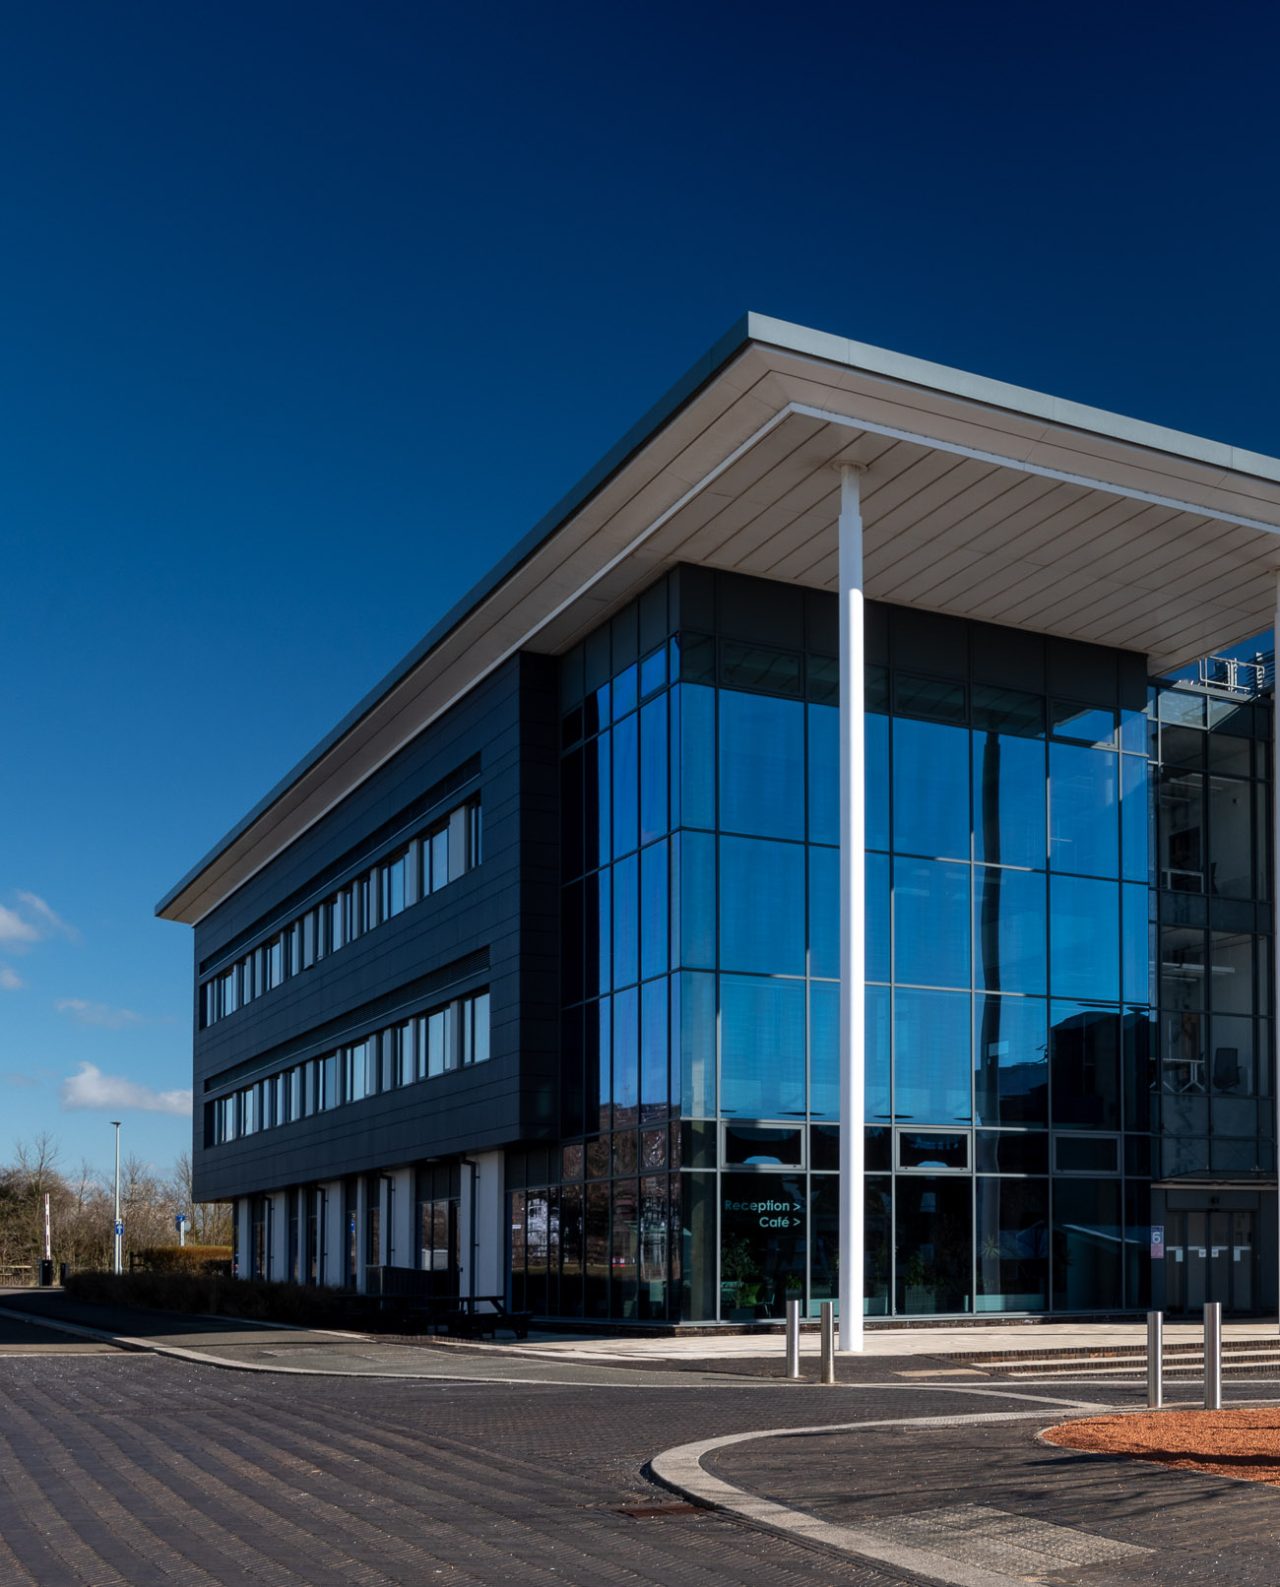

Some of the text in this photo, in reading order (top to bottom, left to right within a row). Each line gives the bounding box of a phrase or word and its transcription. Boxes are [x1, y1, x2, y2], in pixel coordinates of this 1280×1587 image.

[724, 1199, 790, 1213] Reception
[759, 1216, 790, 1228] Café
[1152, 1231, 1161, 1244] 6
